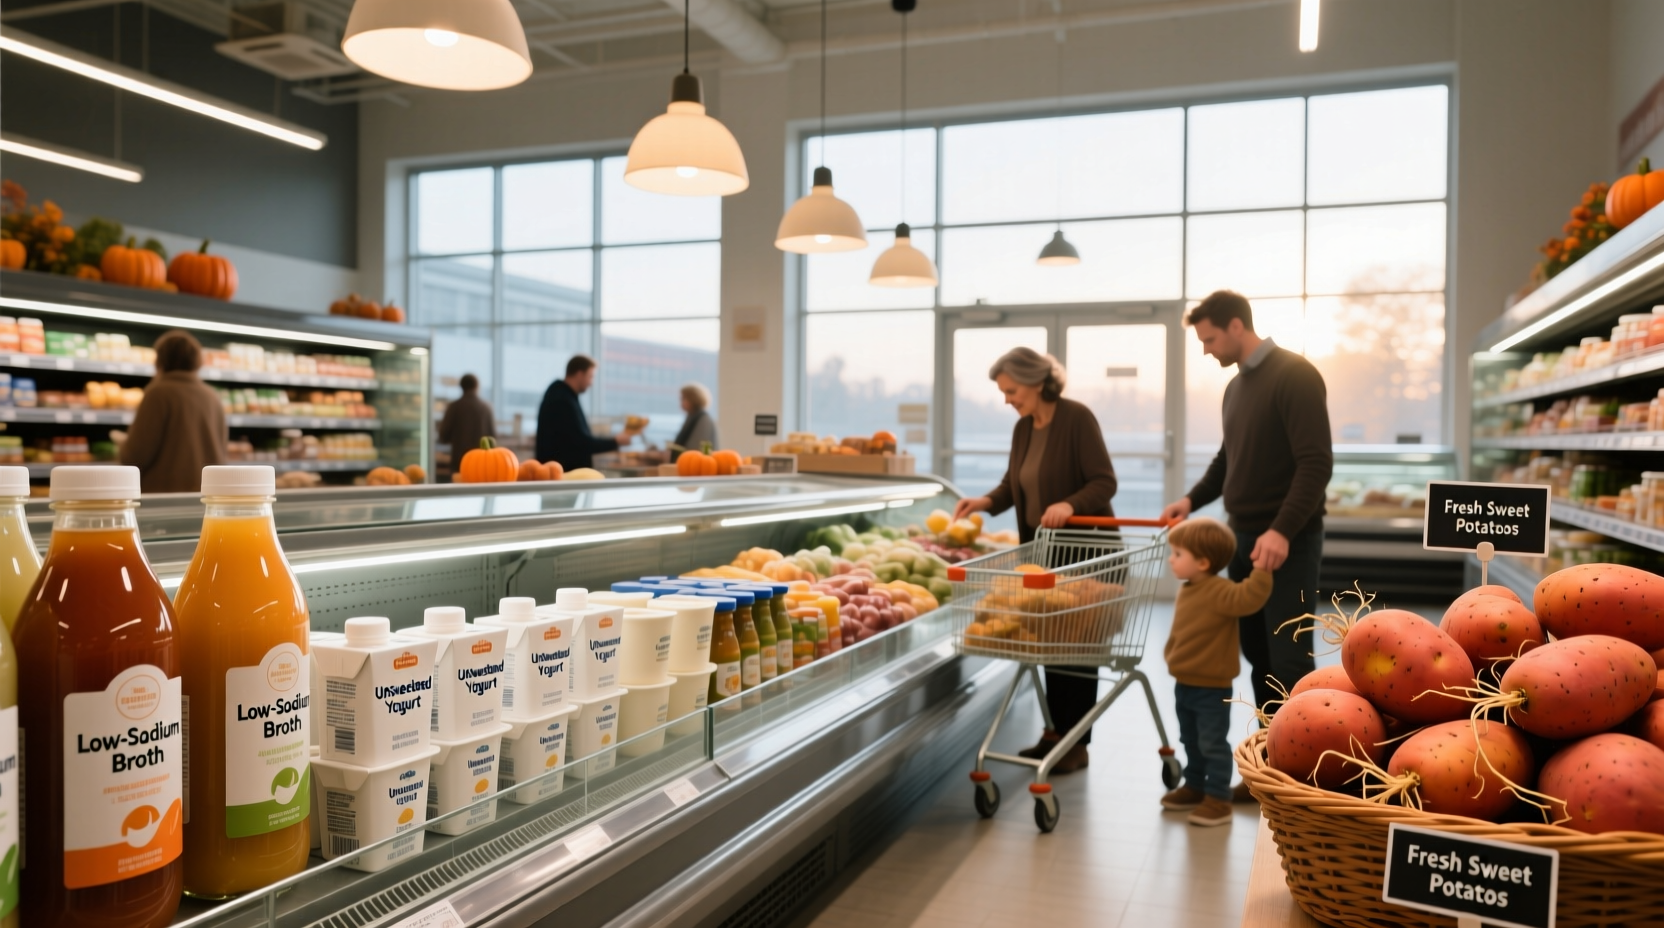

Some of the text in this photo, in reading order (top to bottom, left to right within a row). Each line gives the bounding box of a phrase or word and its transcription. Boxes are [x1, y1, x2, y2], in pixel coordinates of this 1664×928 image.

[1444, 499, 1530, 518] Fresh Sweet
[263, 714, 302, 738] Broth
[112, 745, 164, 773] Broth
[1407, 843, 1533, 887] Fresh Sweet
[1429, 872, 1509, 908] Potatos
